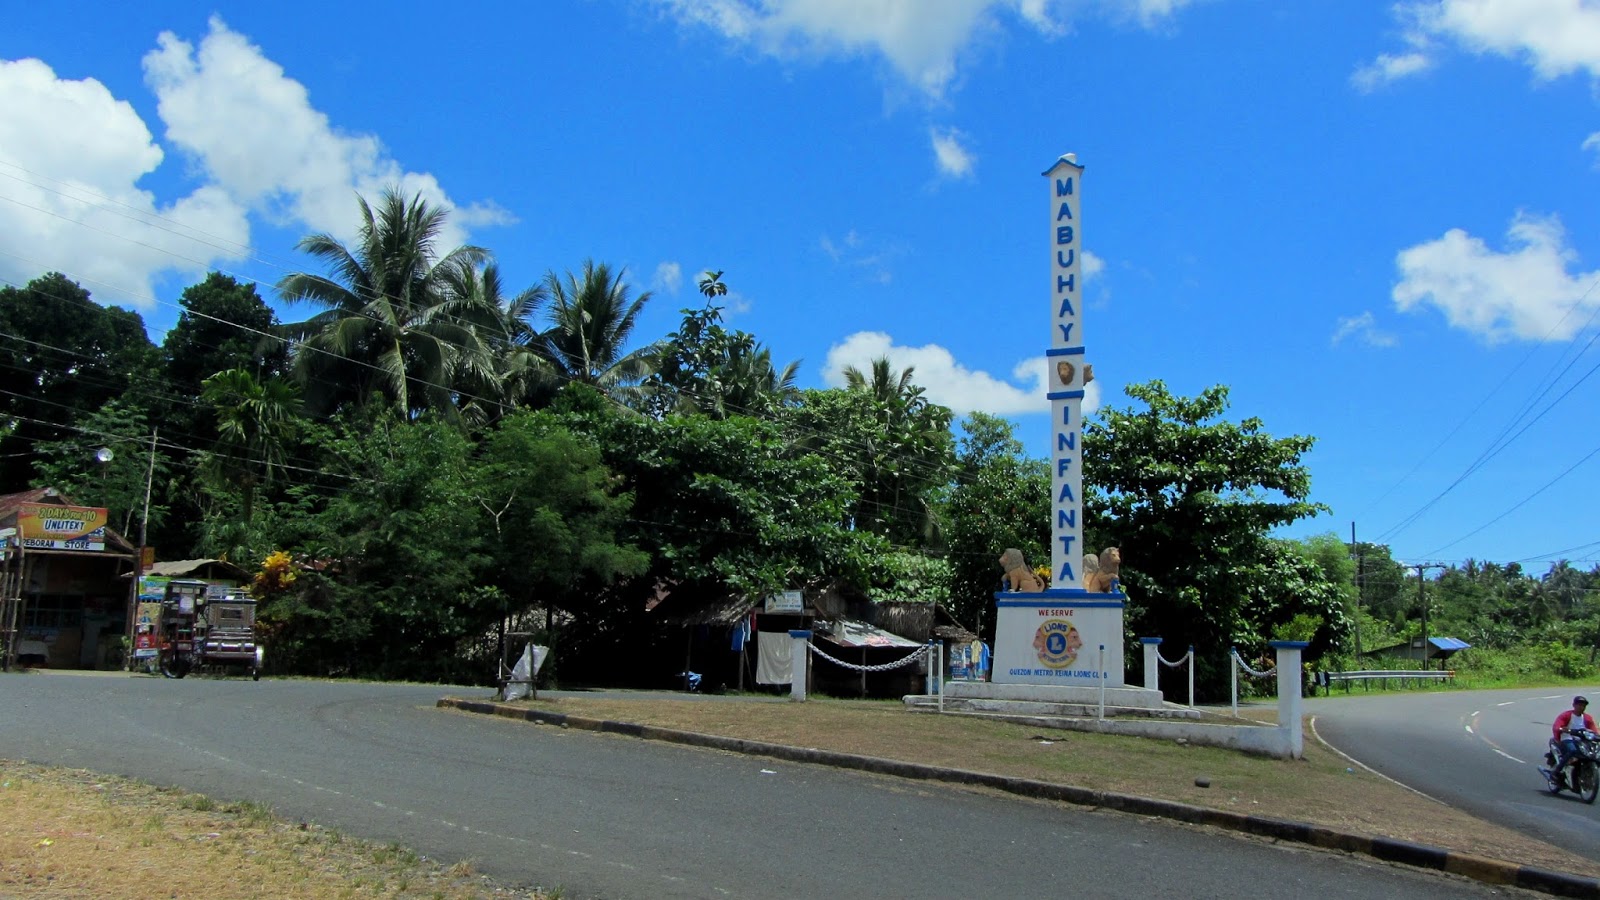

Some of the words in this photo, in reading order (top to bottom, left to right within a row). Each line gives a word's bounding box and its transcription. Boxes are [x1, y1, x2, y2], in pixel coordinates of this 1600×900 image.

[1056, 177, 1074, 342] MABUHAY
[1058, 406, 1075, 581] INFANTA
[47, 508, 69, 520] DAYS
[44, 520, 85, 531] UNLITEXT
[64, 541, 90, 549] STORE
[1044, 623, 1068, 633] LIONS
[1034, 669, 1054, 677] METRO
[1092, 671, 1108, 679] CLB
